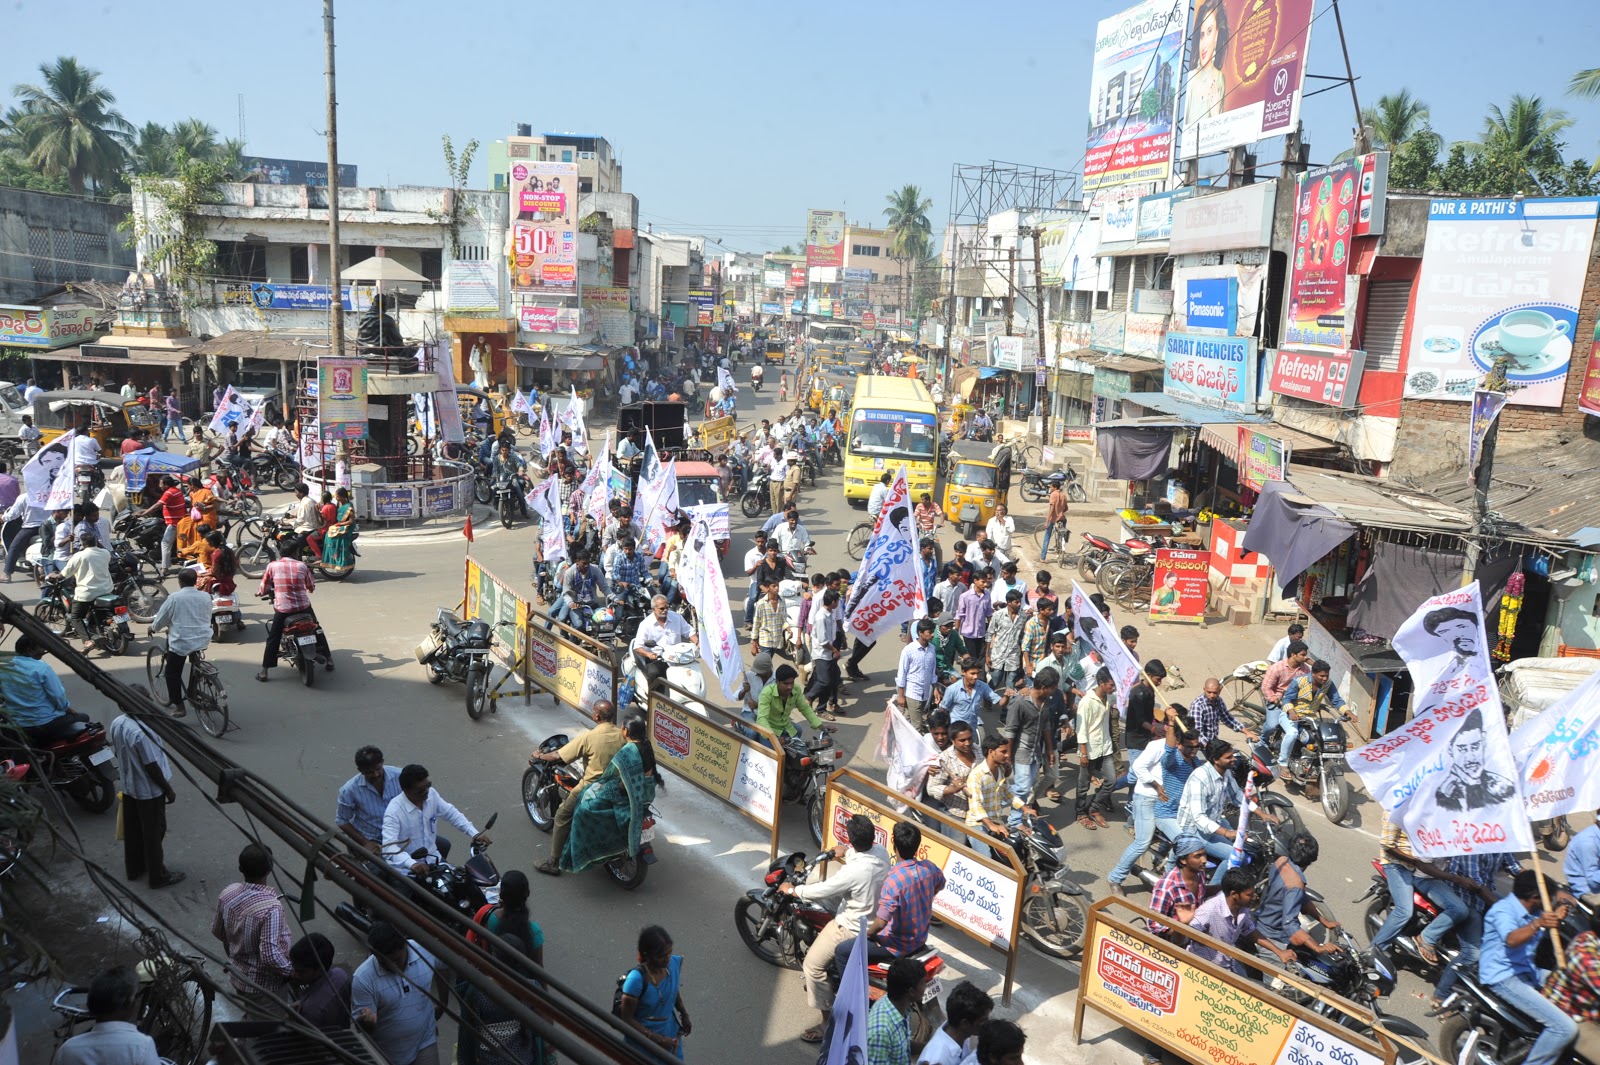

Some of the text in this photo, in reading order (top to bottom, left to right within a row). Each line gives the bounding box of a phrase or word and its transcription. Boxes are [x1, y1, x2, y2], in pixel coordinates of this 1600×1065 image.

[1431, 202, 1455, 215] DNR
[1458, 203, 1467, 214] &
[1189, 301, 1224, 318] Panasonic
[1167, 338, 1244, 362] SARAT AGENCIES
[1277, 355, 1325, 382] Refresh
[1279, 378, 1311, 394] Amalapuram
[876, 413, 904, 421] CHAITANYA
[946, 879, 975, 904] నెమ్మది
[951, 861, 973, 882] వేగం
[976, 875, 999, 899] వద్దు
[1103, 946, 1142, 974] చందన
[1109, 928, 1180, 970] షాపింగ్ మాల్
[1184, 966, 1200, 983] మన
[1102, 981, 1163, 1017] అమలాపురం
[1176, 1027, 1207, 1051] చందన
[1295, 1026, 1325, 1053] వేగం
